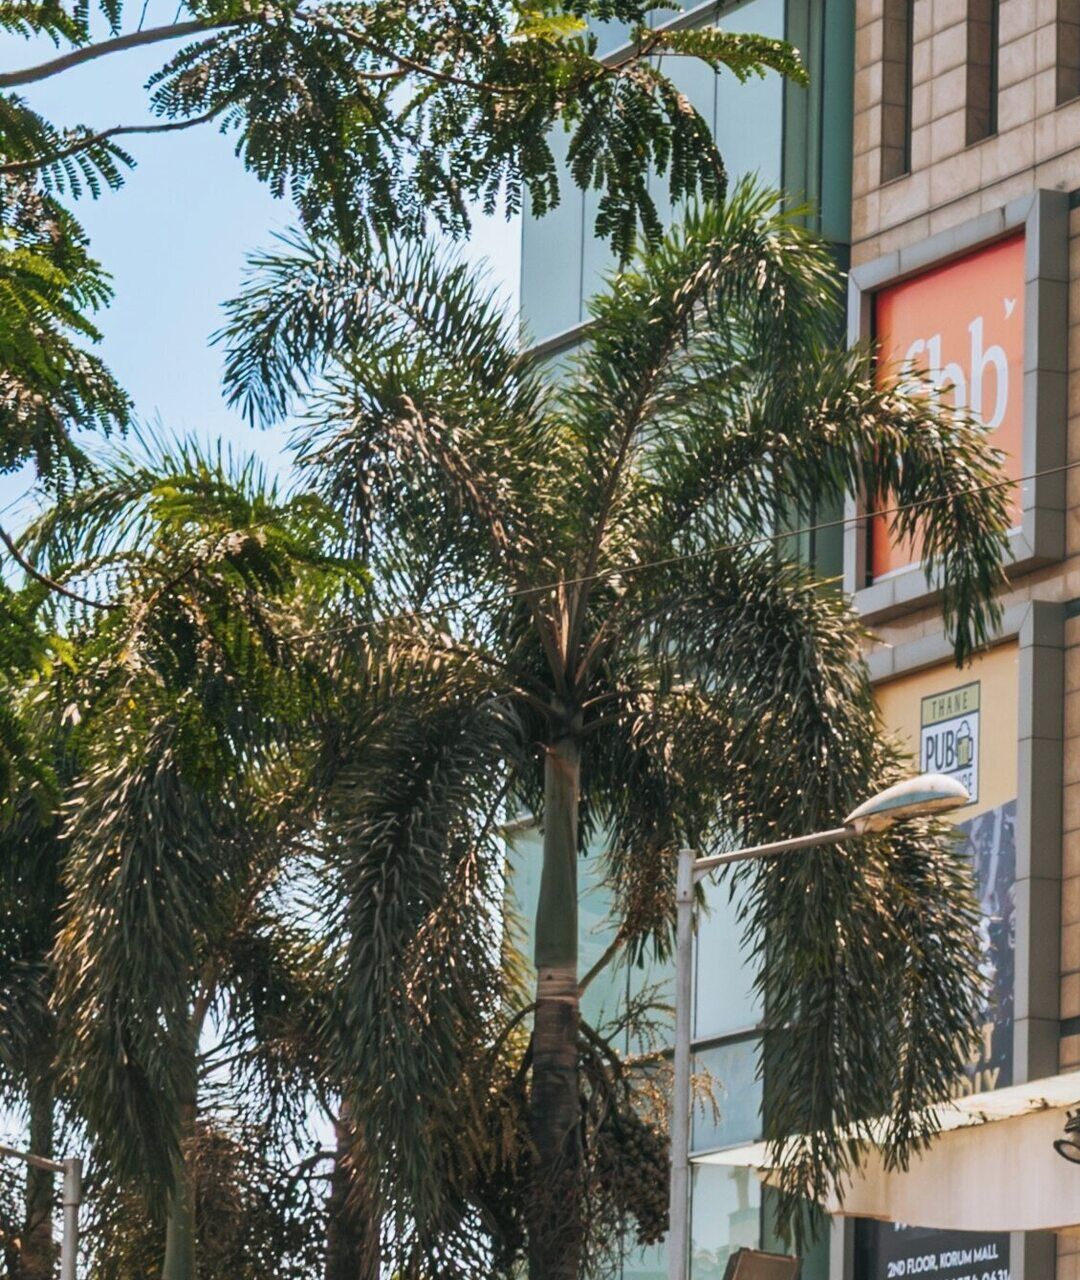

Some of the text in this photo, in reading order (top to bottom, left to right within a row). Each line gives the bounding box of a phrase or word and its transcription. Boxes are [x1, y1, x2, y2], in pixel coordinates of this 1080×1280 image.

[932, 691, 968, 720] THANE
[926, 729, 955, 771] PUB
[887, 1243, 999, 1279] 2ND FLOOR, KORUM MALL
